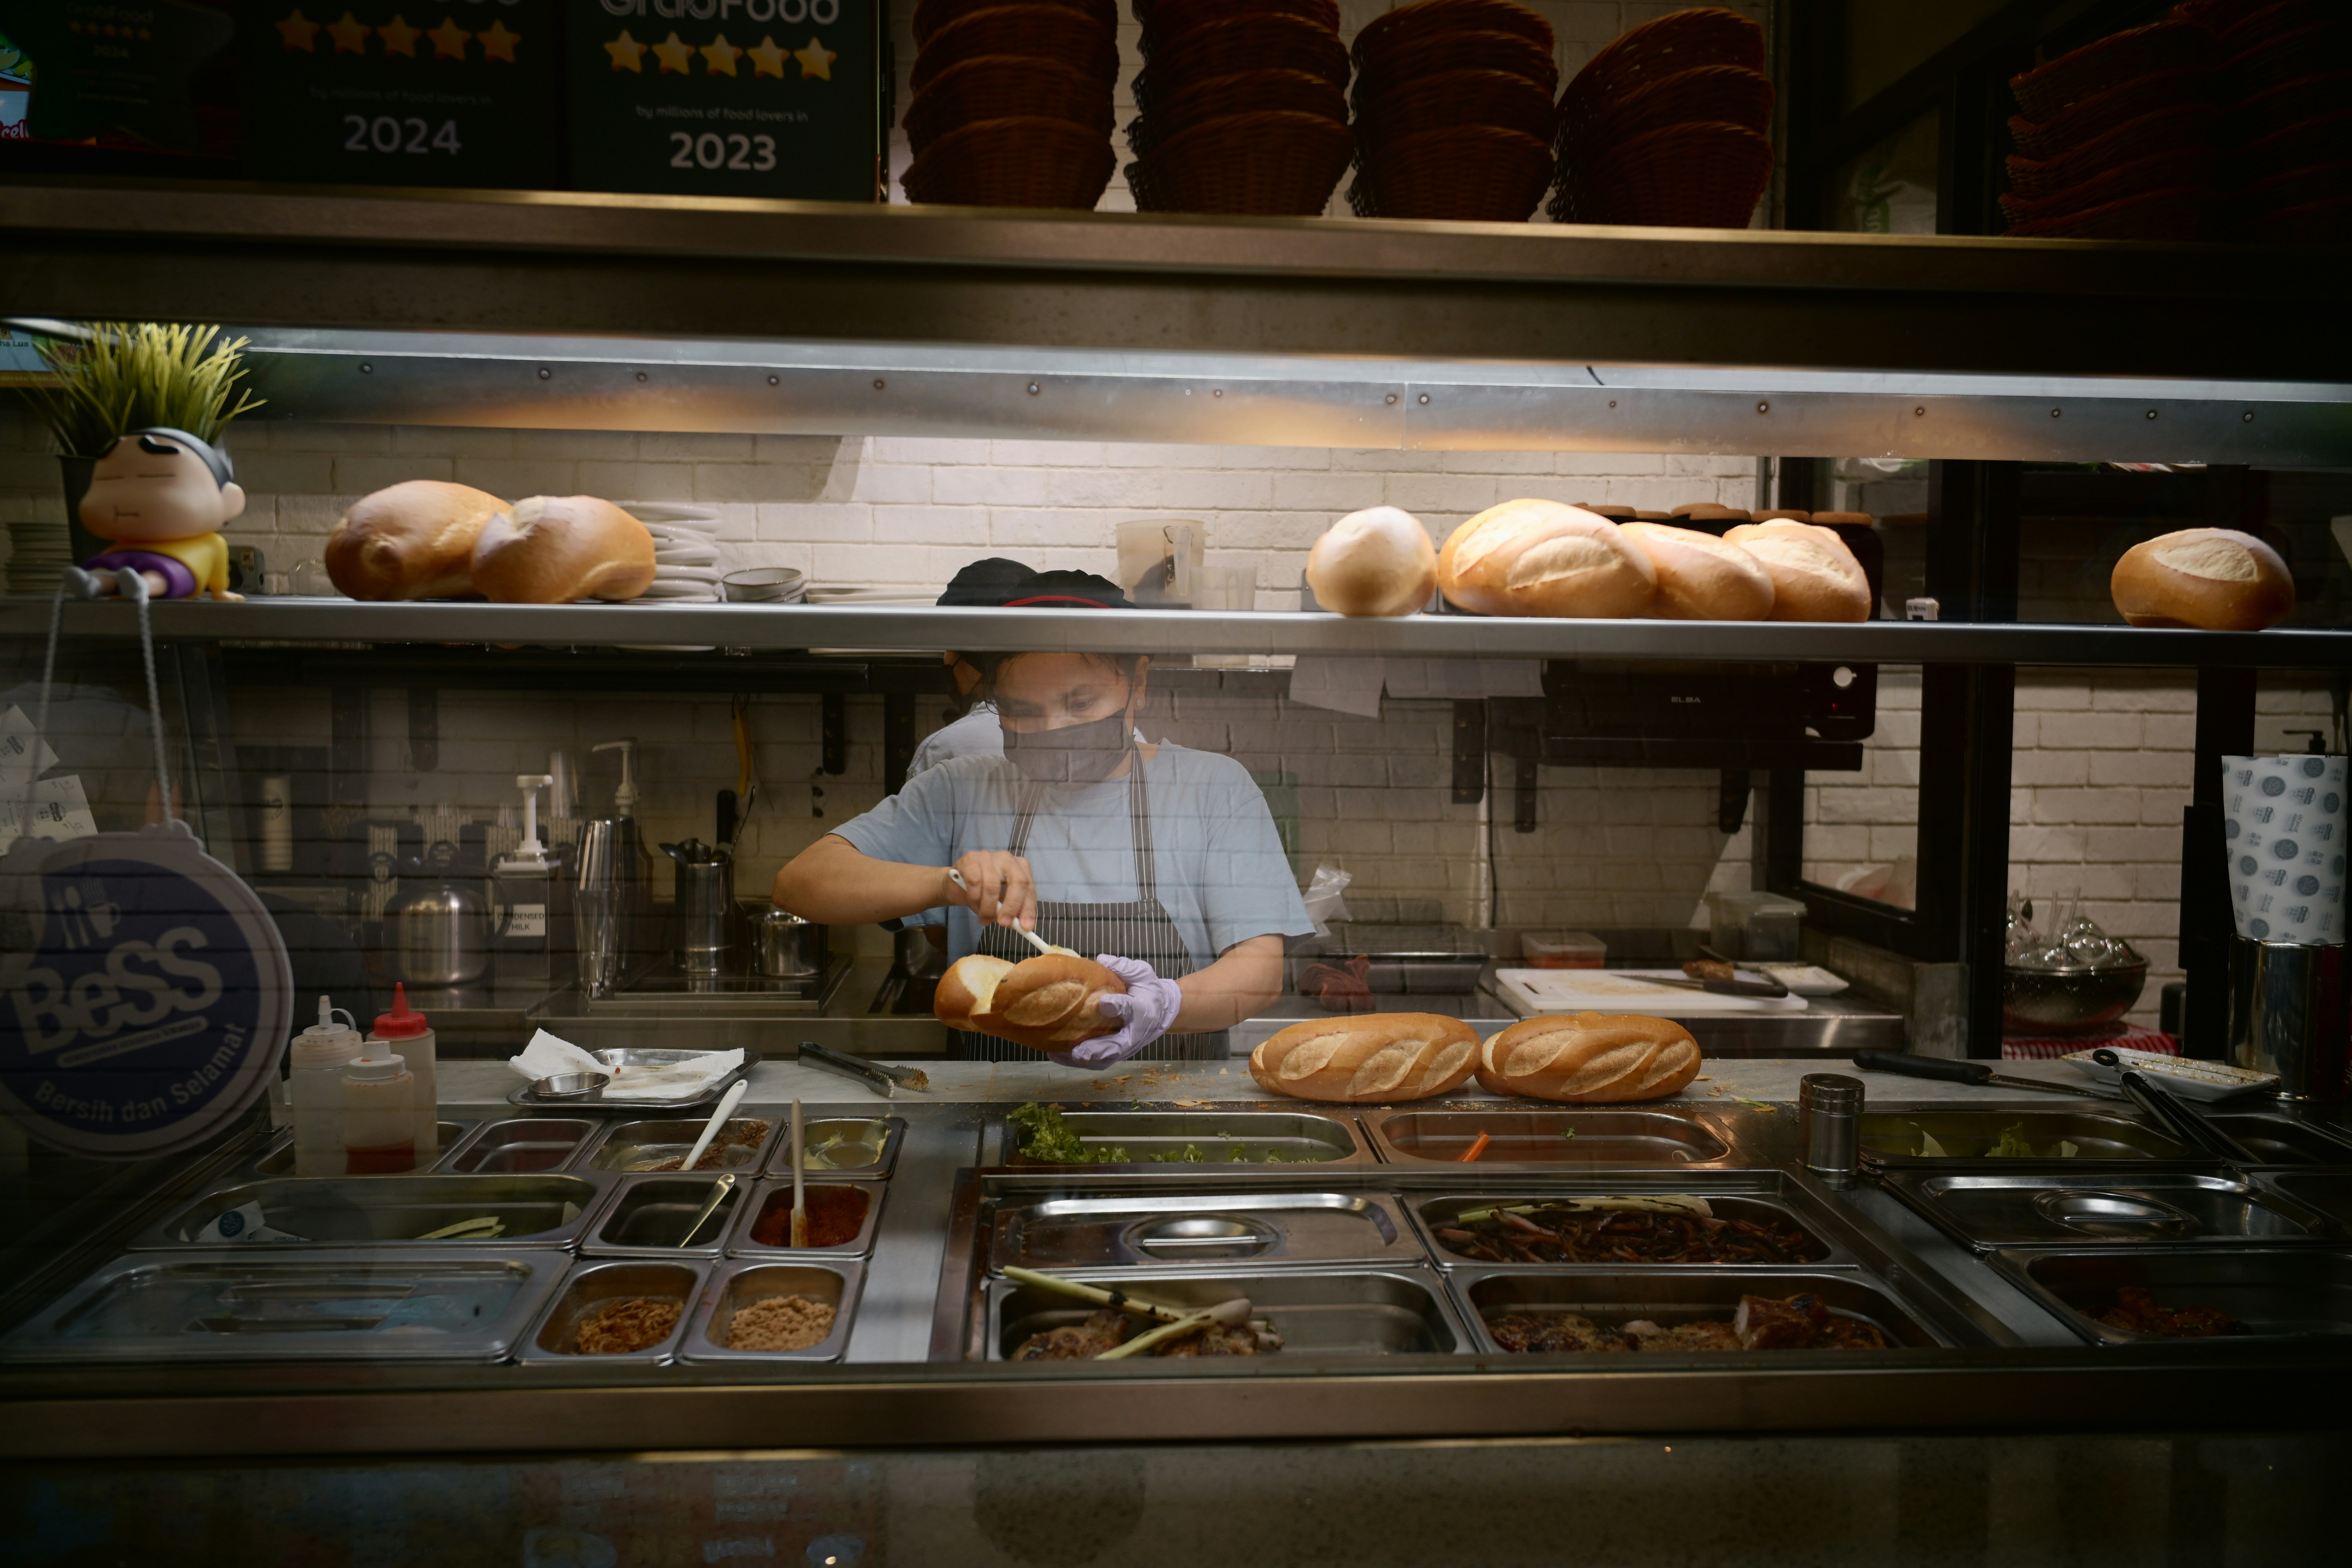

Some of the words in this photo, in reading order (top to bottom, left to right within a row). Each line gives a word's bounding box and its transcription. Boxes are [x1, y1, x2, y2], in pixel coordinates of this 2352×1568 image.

[401, 90, 435, 103] food
[436, 91, 477, 105] lovers
[635, 104, 653, 119] by
[655, 106, 704, 119] millions
[706, 107, 720, 119] of
[723, 107, 754, 121] food
[755, 108, 794, 122] lovers
[796, 110, 808, 122] in
[343, 114, 463, 155] 2024
[669, 131, 777, 172] 2023
[497, 912, 545, 920] CDENSED
[10, 926, 223, 1055] BeSS
[34, 1080, 114, 1122] Bersih
[121, 1097, 168, 1123] dan
[170, 1023, 248, 1105] Selamat
